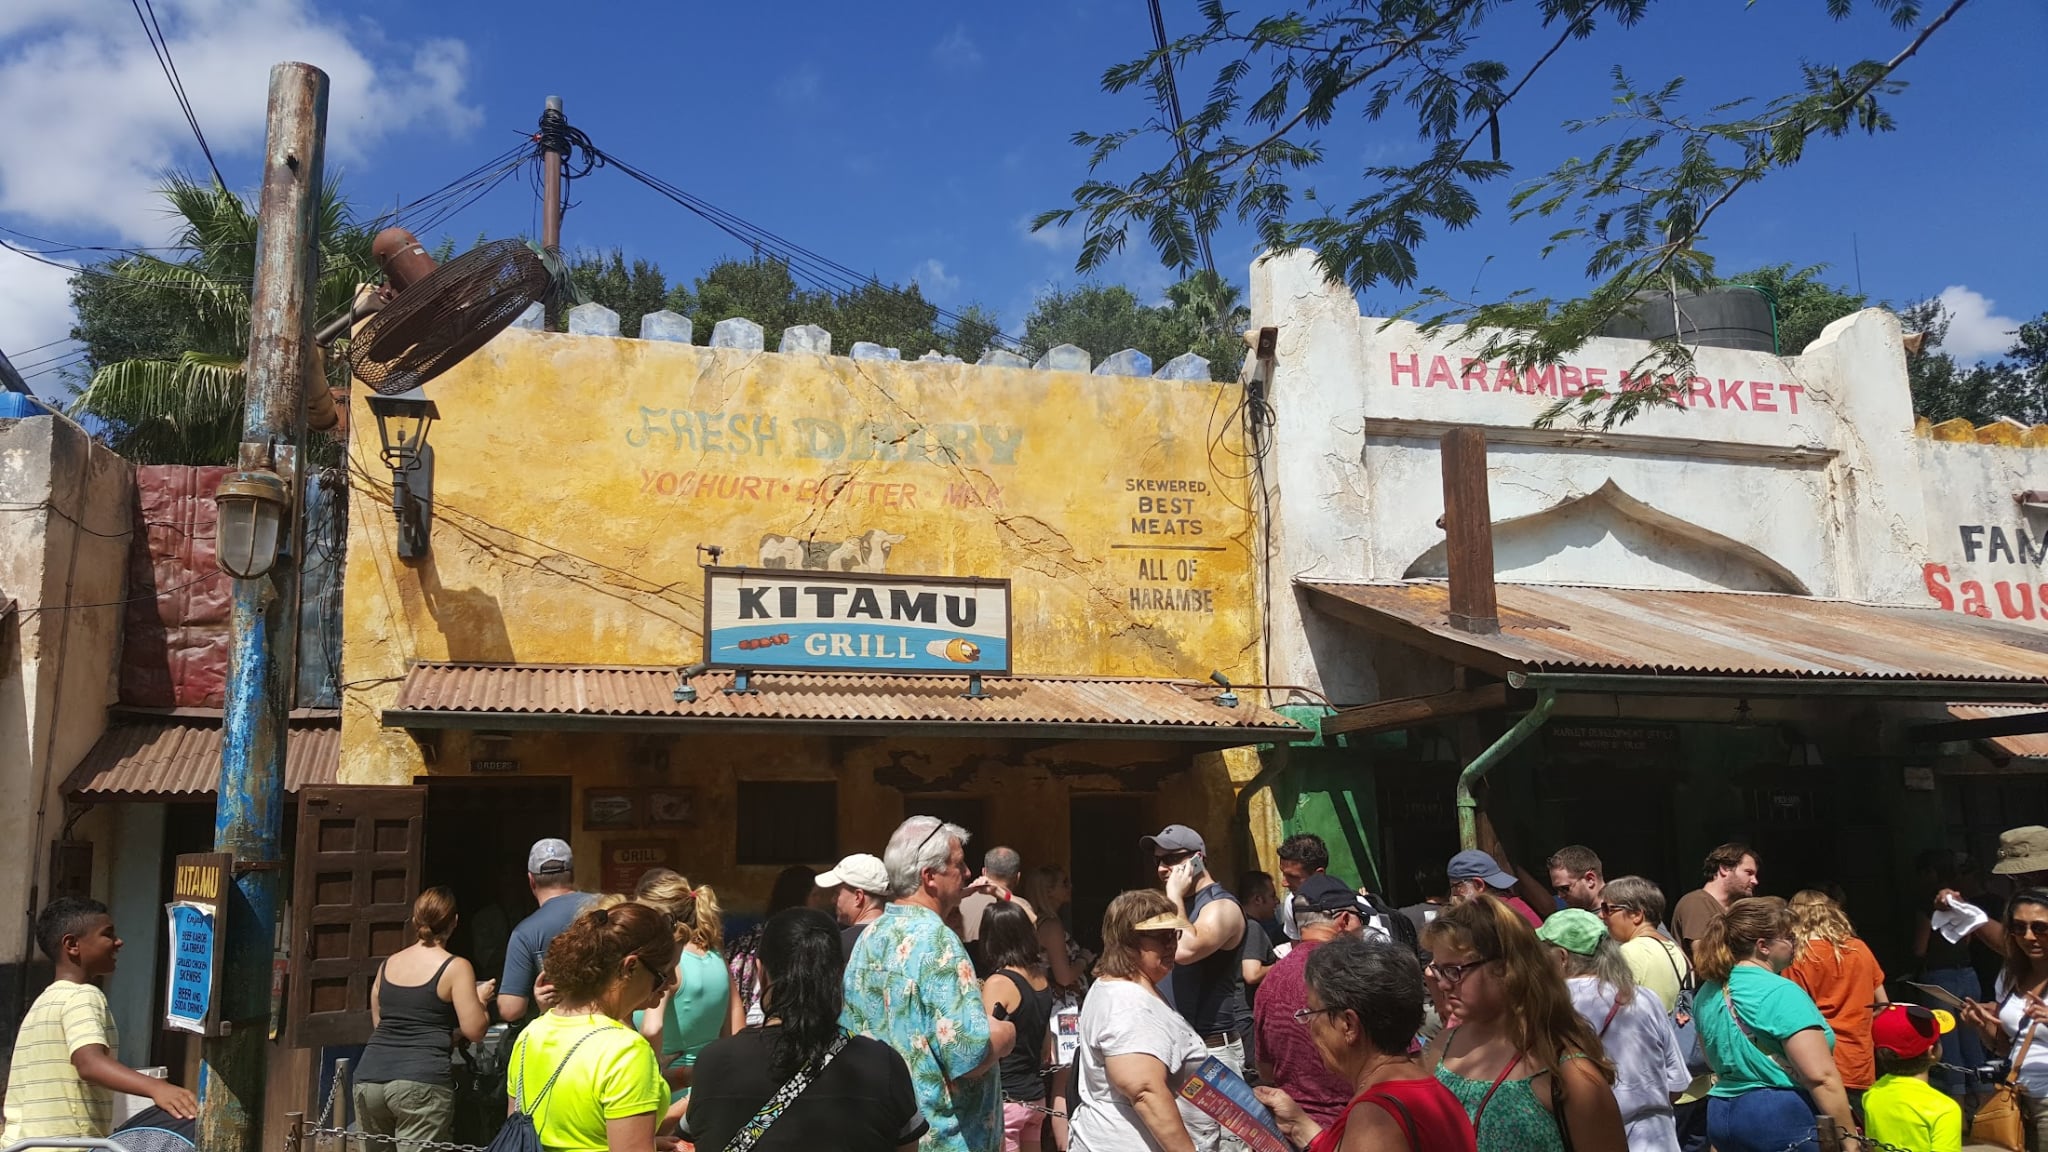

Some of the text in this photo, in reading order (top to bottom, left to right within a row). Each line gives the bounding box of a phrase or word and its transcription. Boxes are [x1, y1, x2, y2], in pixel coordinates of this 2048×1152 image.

[1389, 352, 1805, 415] HARAMBE MARKET
[626, 406, 1024, 466] FRESH DAIRY
[639, 468, 1006, 509] YOGHURT BUTTER MILK
[1139, 497, 1196, 515] BEST
[1131, 518, 1203, 535] MEATS
[1138, 558, 1198, 582] ALL OF
[737, 586, 977, 628] KITAMU
[1130, 587, 1214, 613] HARAMBE
[804, 632, 916, 660] GRILL
[621, 849, 656, 861] GRILL
[176, 865, 219, 899] KITAMU
[187, 913, 204, 928] Enjoy
[178, 987, 191, 1000] BEER
[175, 1000, 204, 1014] SODA DRINKS
[1061, 1041, 1075, 1051] THE
